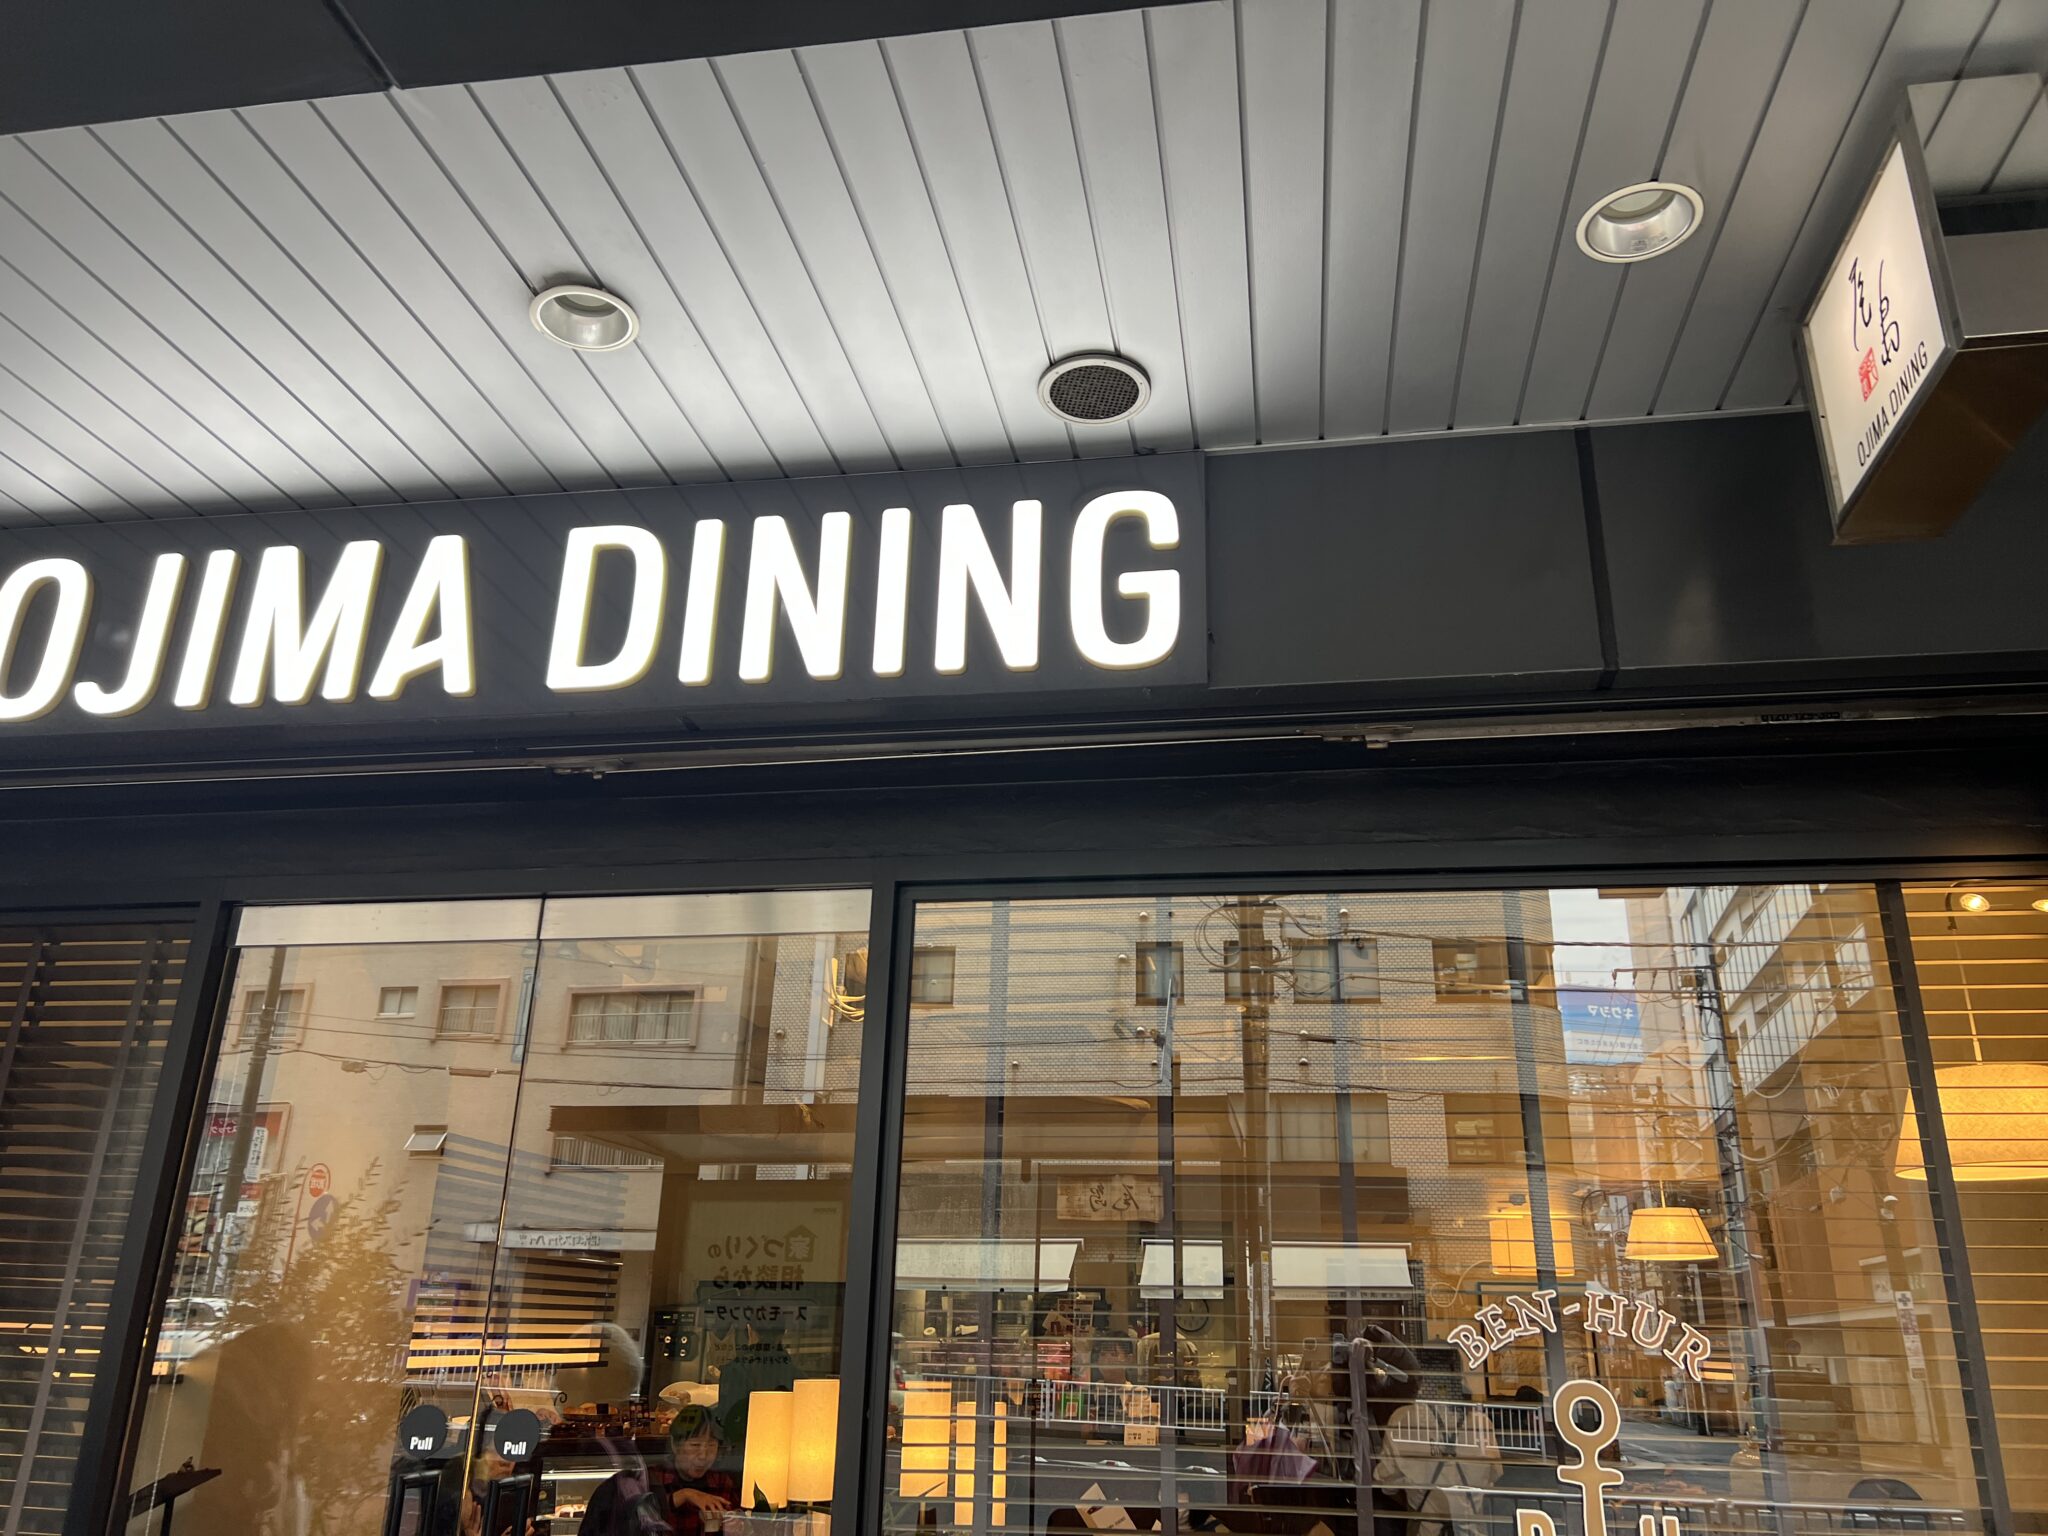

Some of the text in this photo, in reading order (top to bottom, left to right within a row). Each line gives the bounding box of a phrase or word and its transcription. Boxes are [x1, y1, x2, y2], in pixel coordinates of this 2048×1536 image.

[1857, 404, 1891, 468] OJIMA
[1888, 341, 1929, 418] DINING
[0, 489, 1182, 722] OJIMA DINING
[1448, 1290, 1712, 1382] BEN-HUR
[409, 1436, 433, 1450] Pull
[503, 1441, 527, 1455] Pull
